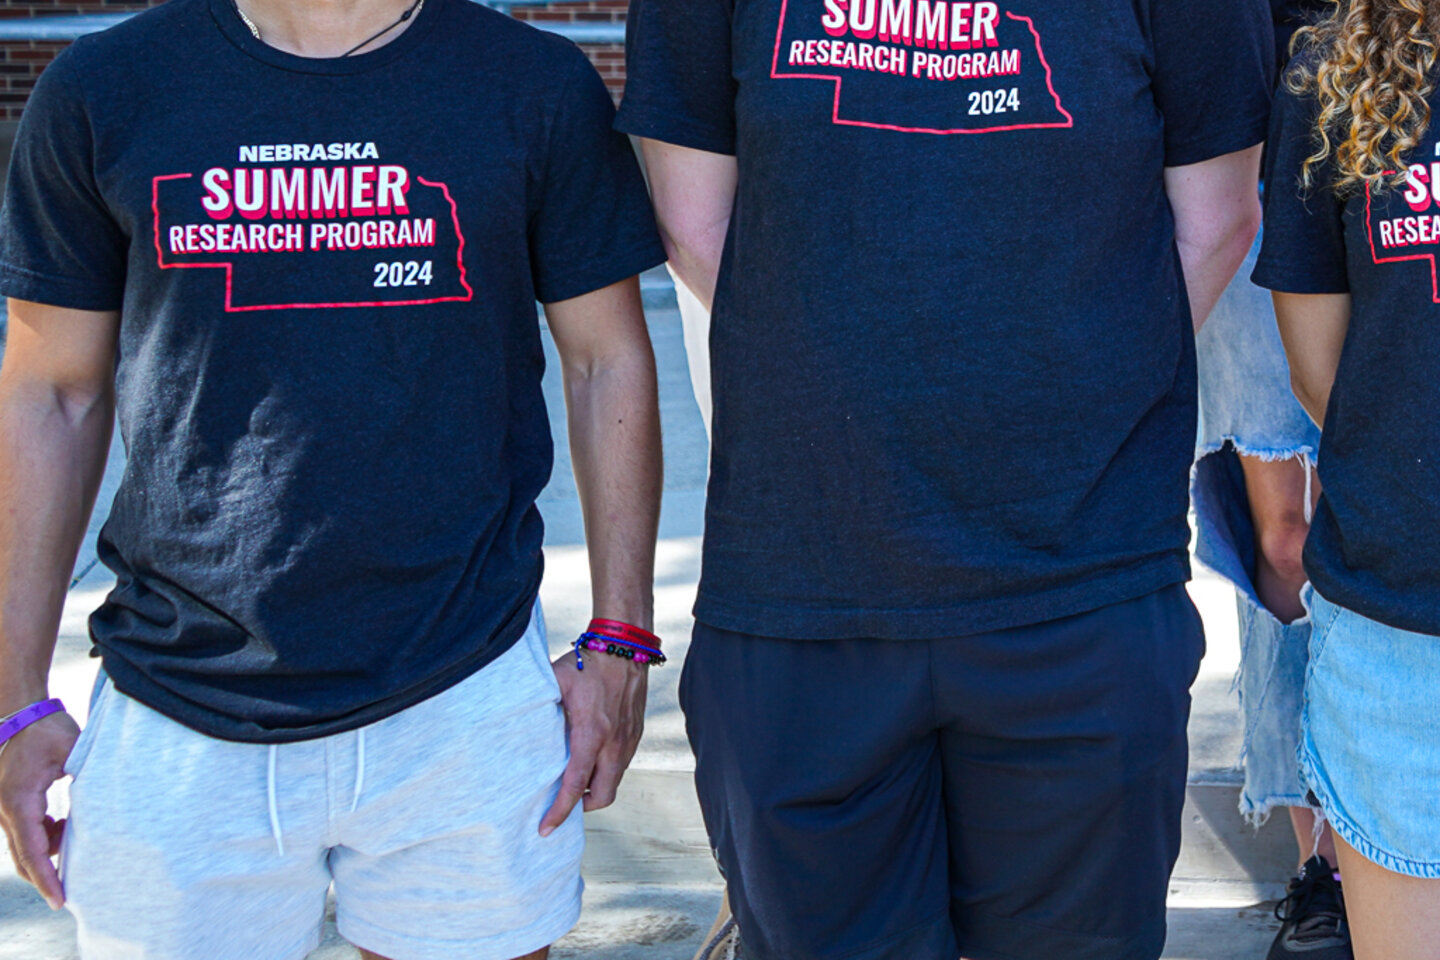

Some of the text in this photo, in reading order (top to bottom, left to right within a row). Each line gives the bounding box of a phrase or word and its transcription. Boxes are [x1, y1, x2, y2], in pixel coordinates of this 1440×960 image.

[788, 40, 1021, 80] RESEARCH PROGRAM
[968, 88, 1020, 115] 2024
[239, 142, 379, 162] NEBRASKA
[202, 165, 410, 220] SUMMER
[169, 218, 436, 254] RESEARCH PROGRAM
[373, 261, 433, 287] 2024
